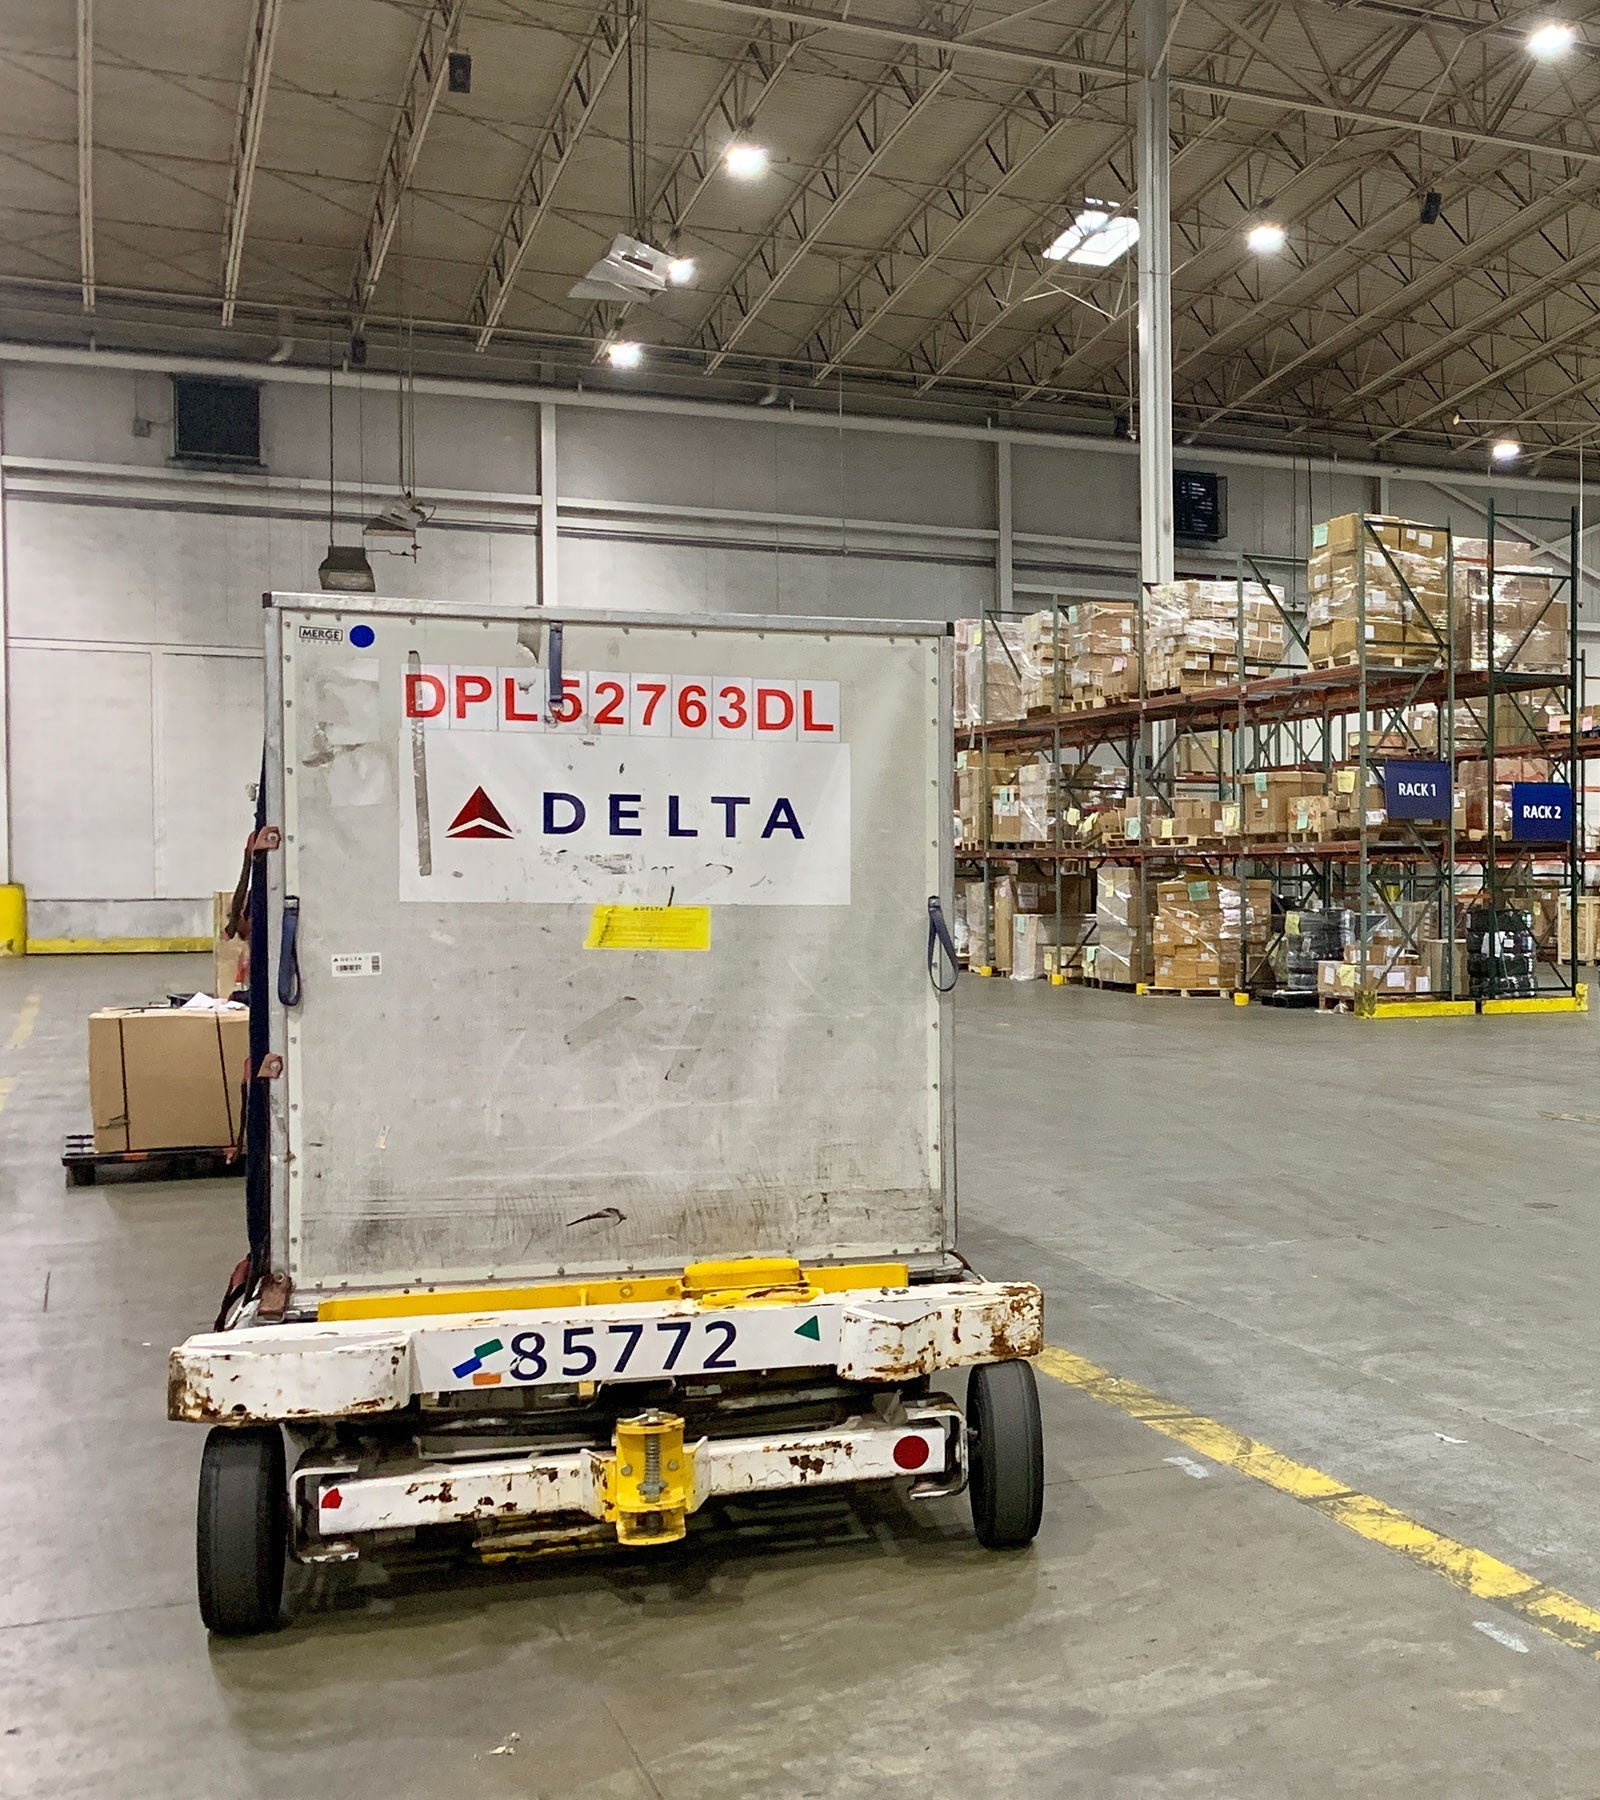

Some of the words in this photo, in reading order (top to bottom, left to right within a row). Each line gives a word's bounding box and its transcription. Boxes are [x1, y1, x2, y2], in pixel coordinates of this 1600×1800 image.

[302, 629, 340, 640] MERGE
[404, 673, 835, 732] DPL52763DL
[1398, 782, 1430, 797] RACK
[1430, 783, 1437, 797] 1
[542, 791, 805, 840] DELTA
[1522, 804, 1552, 819] RACK
[1554, 806, 1562, 819] 2
[509, 1320, 738, 1381] 85772
